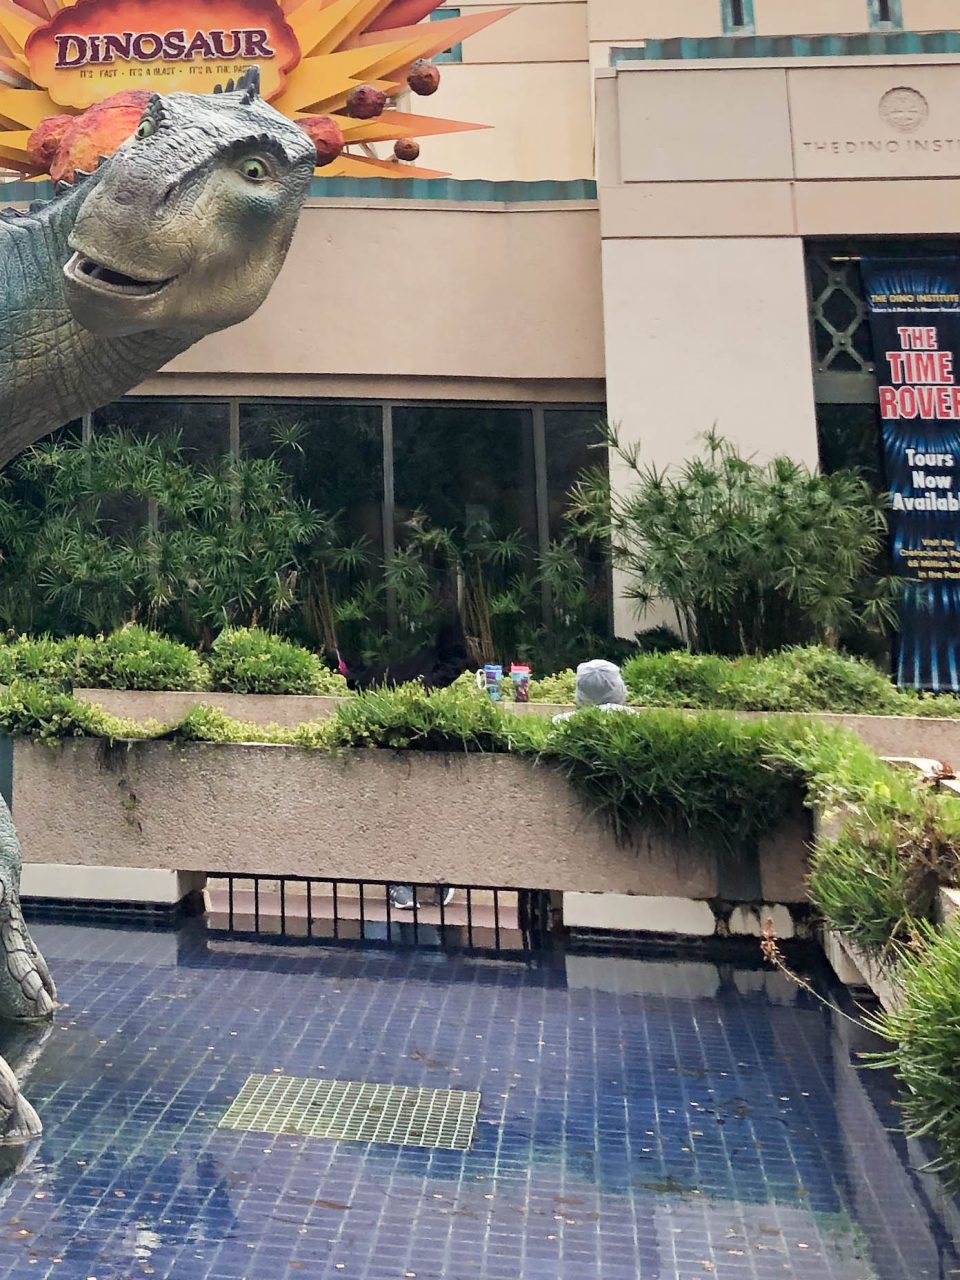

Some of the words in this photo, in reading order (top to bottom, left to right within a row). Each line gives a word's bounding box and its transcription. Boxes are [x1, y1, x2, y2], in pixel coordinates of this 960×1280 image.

[55, 29, 274, 67] DINOSAUR
[100, 69, 118, 78] FAST
[146, 68, 151, 76] A
[216, 65, 231, 73] THE
[803, 141, 839, 154] THE
[846, 140, 899, 153] DINO
[871, 294, 887, 302] THE
[889, 294, 915, 302] DINO
[897, 326, 938, 350] THE
[886, 351, 954, 384] TIME
[905, 448, 954, 467] Tours
[912, 471, 952, 489] Now
